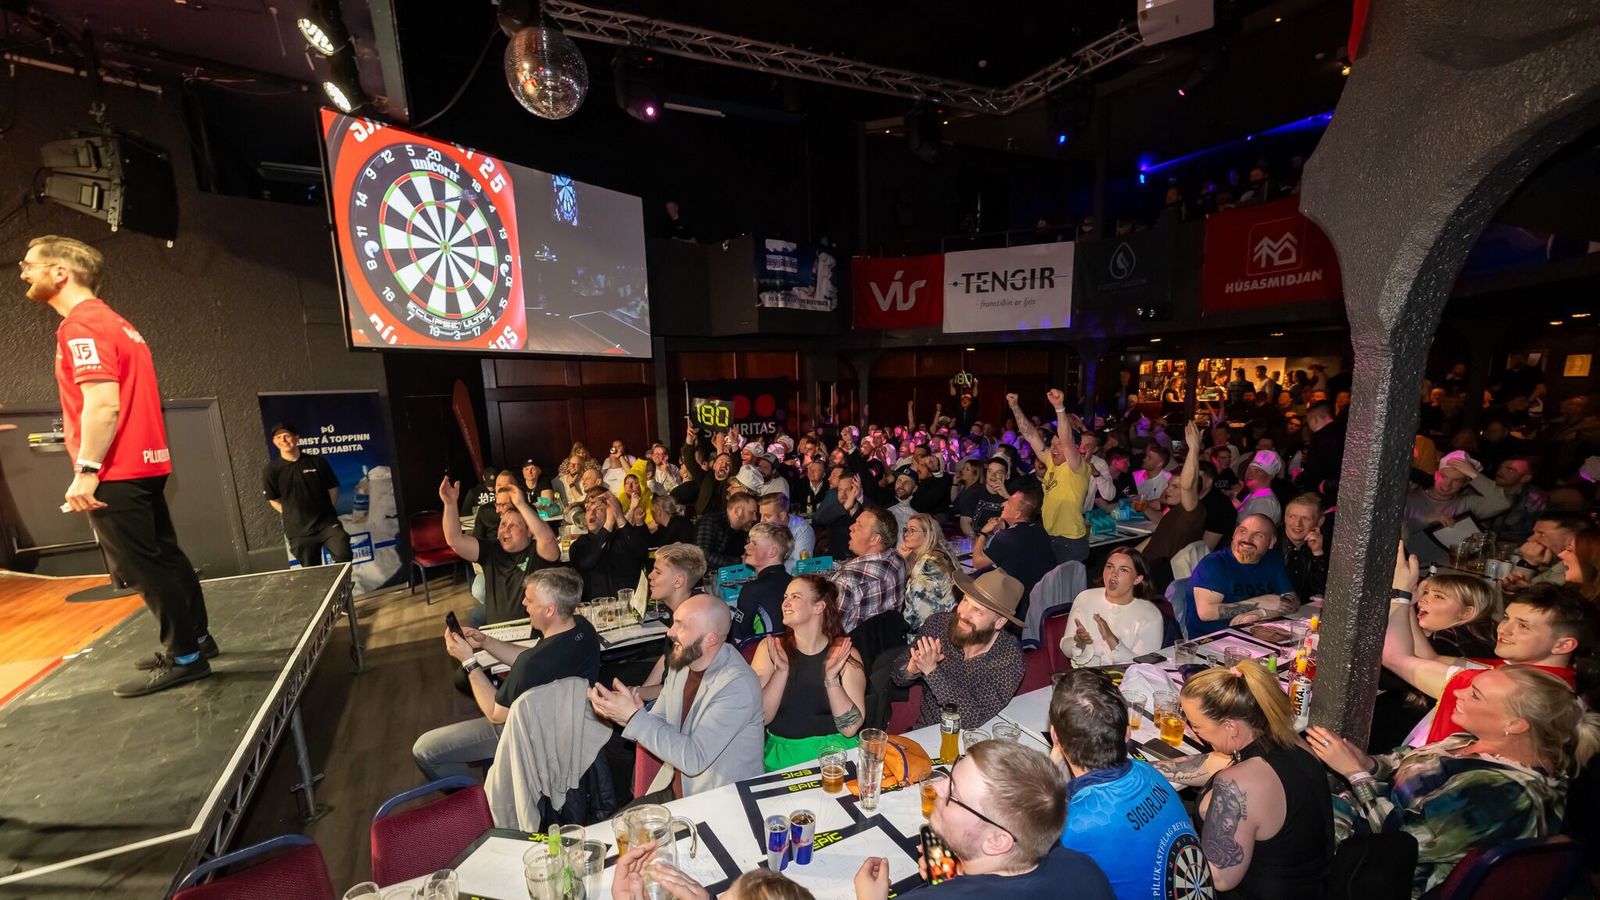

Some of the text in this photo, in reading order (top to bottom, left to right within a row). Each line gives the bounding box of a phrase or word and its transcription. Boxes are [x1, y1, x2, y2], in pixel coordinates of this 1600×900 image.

[380, 149, 396, 164] 12
[405, 144, 415, 157] 5
[427, 148, 442, 162] 20
[365, 167, 377, 180] 9
[410, 157, 459, 182] unicorn
[454, 163, 460, 173] 1
[471, 178, 482, 193] 18
[355, 191, 368, 207] 14
[488, 204, 496, 213] 4
[356, 225, 368, 238] 11
[498, 227, 508, 241] 13
[366, 259, 378, 271] 8
[962, 267, 1055, 294] TENGIR
[382, 286, 396, 302] 16
[406, 311, 415, 321] 7
[489, 315, 497, 326] 2
[429, 325, 482, 341] 19 3 17
[695, 404, 730, 427] 180
[320, 424, 335, 434] ÞÚ
[704, 421, 777, 438] SRITAS
[296, 433, 371, 446] MST Á TOPPINN
[321, 444, 364, 455] EYJABITA
[1233, 582, 1275, 596] BOSS
[781, 769, 813, 780] EPIC
[788, 780, 821, 792] EPIC
[813, 832, 843, 849] EPIC
